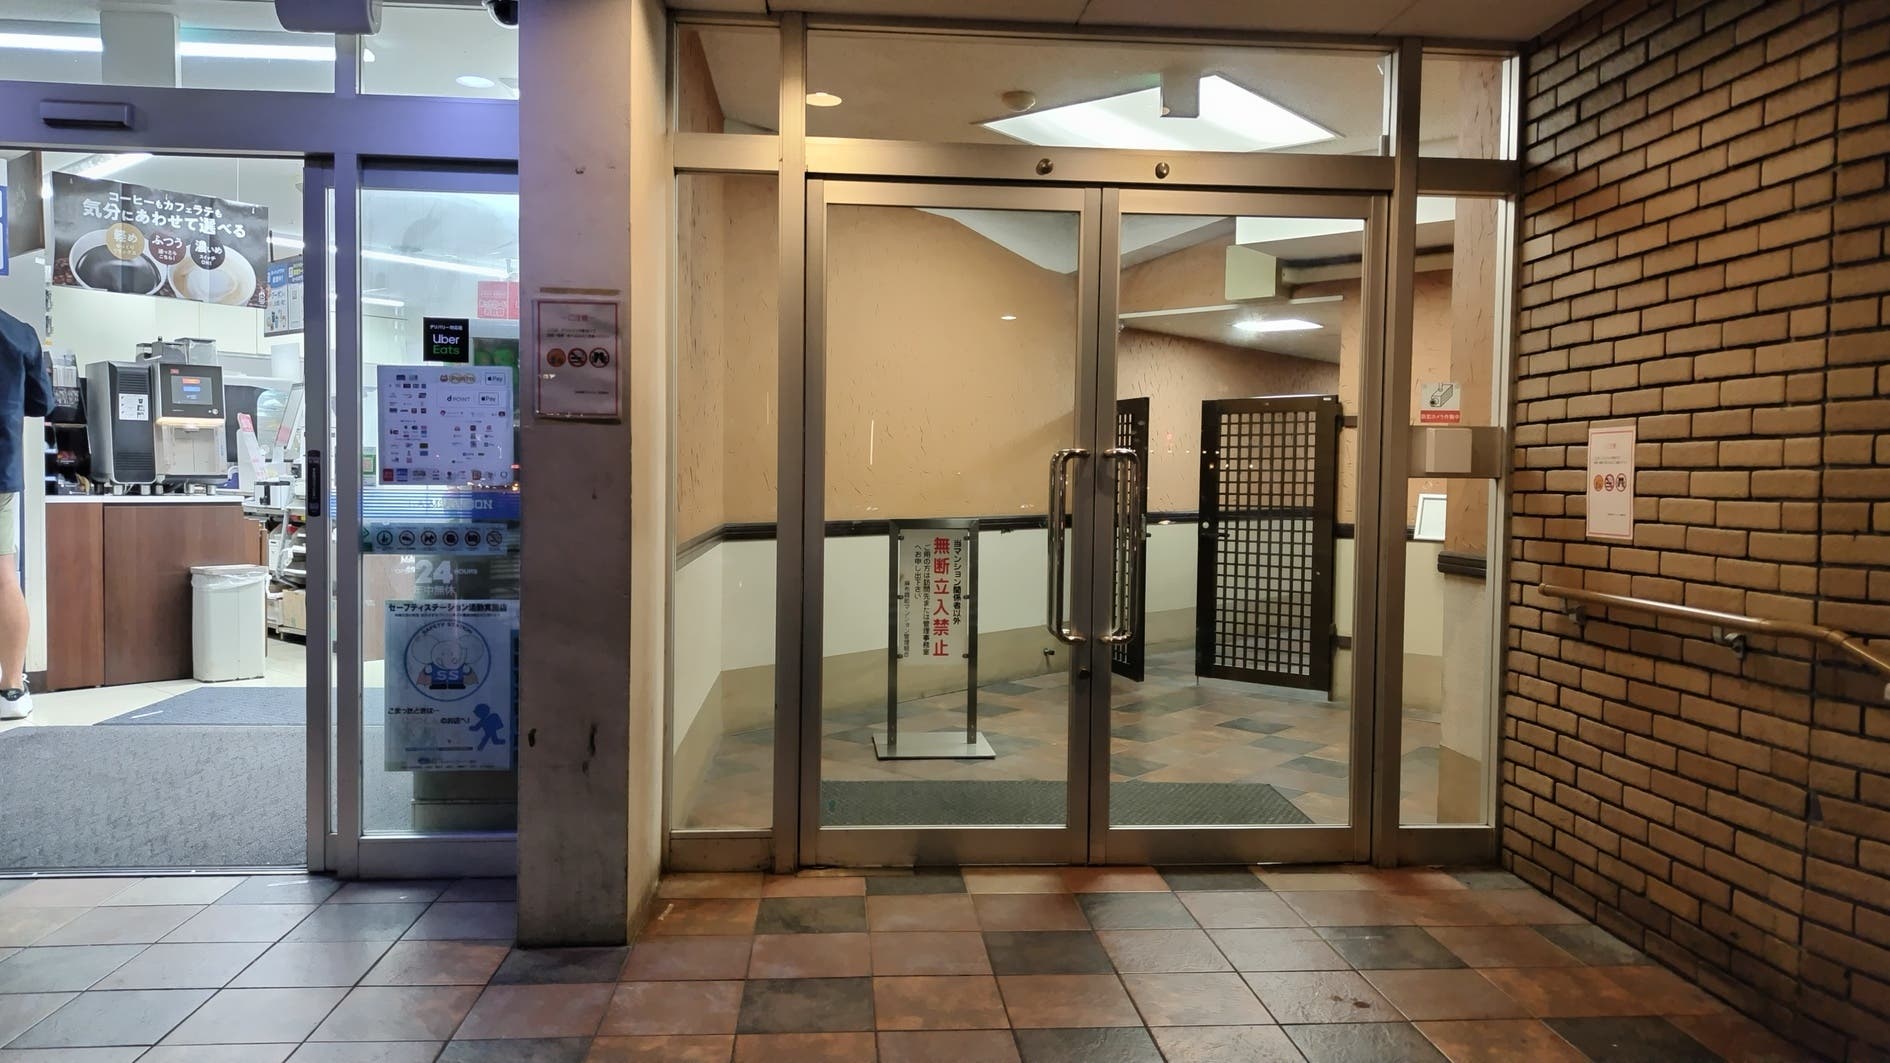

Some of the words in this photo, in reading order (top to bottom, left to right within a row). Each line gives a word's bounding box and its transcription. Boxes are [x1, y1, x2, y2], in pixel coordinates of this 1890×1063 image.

[109, 191, 223, 218] コーヒーもカフェラテも
[82, 198, 246, 239] 気分にあわせて選べる
[151, 234, 183, 249] ふつう
[432, 333, 460, 345] Uber
[432, 345, 460, 355] Eats
[415, 559, 454, 584] 24
[952, 538, 962, 625] 当マンション関係者以外
[932, 537, 950, 657] 無断立入禁止
[435, 671, 459, 680] SS
